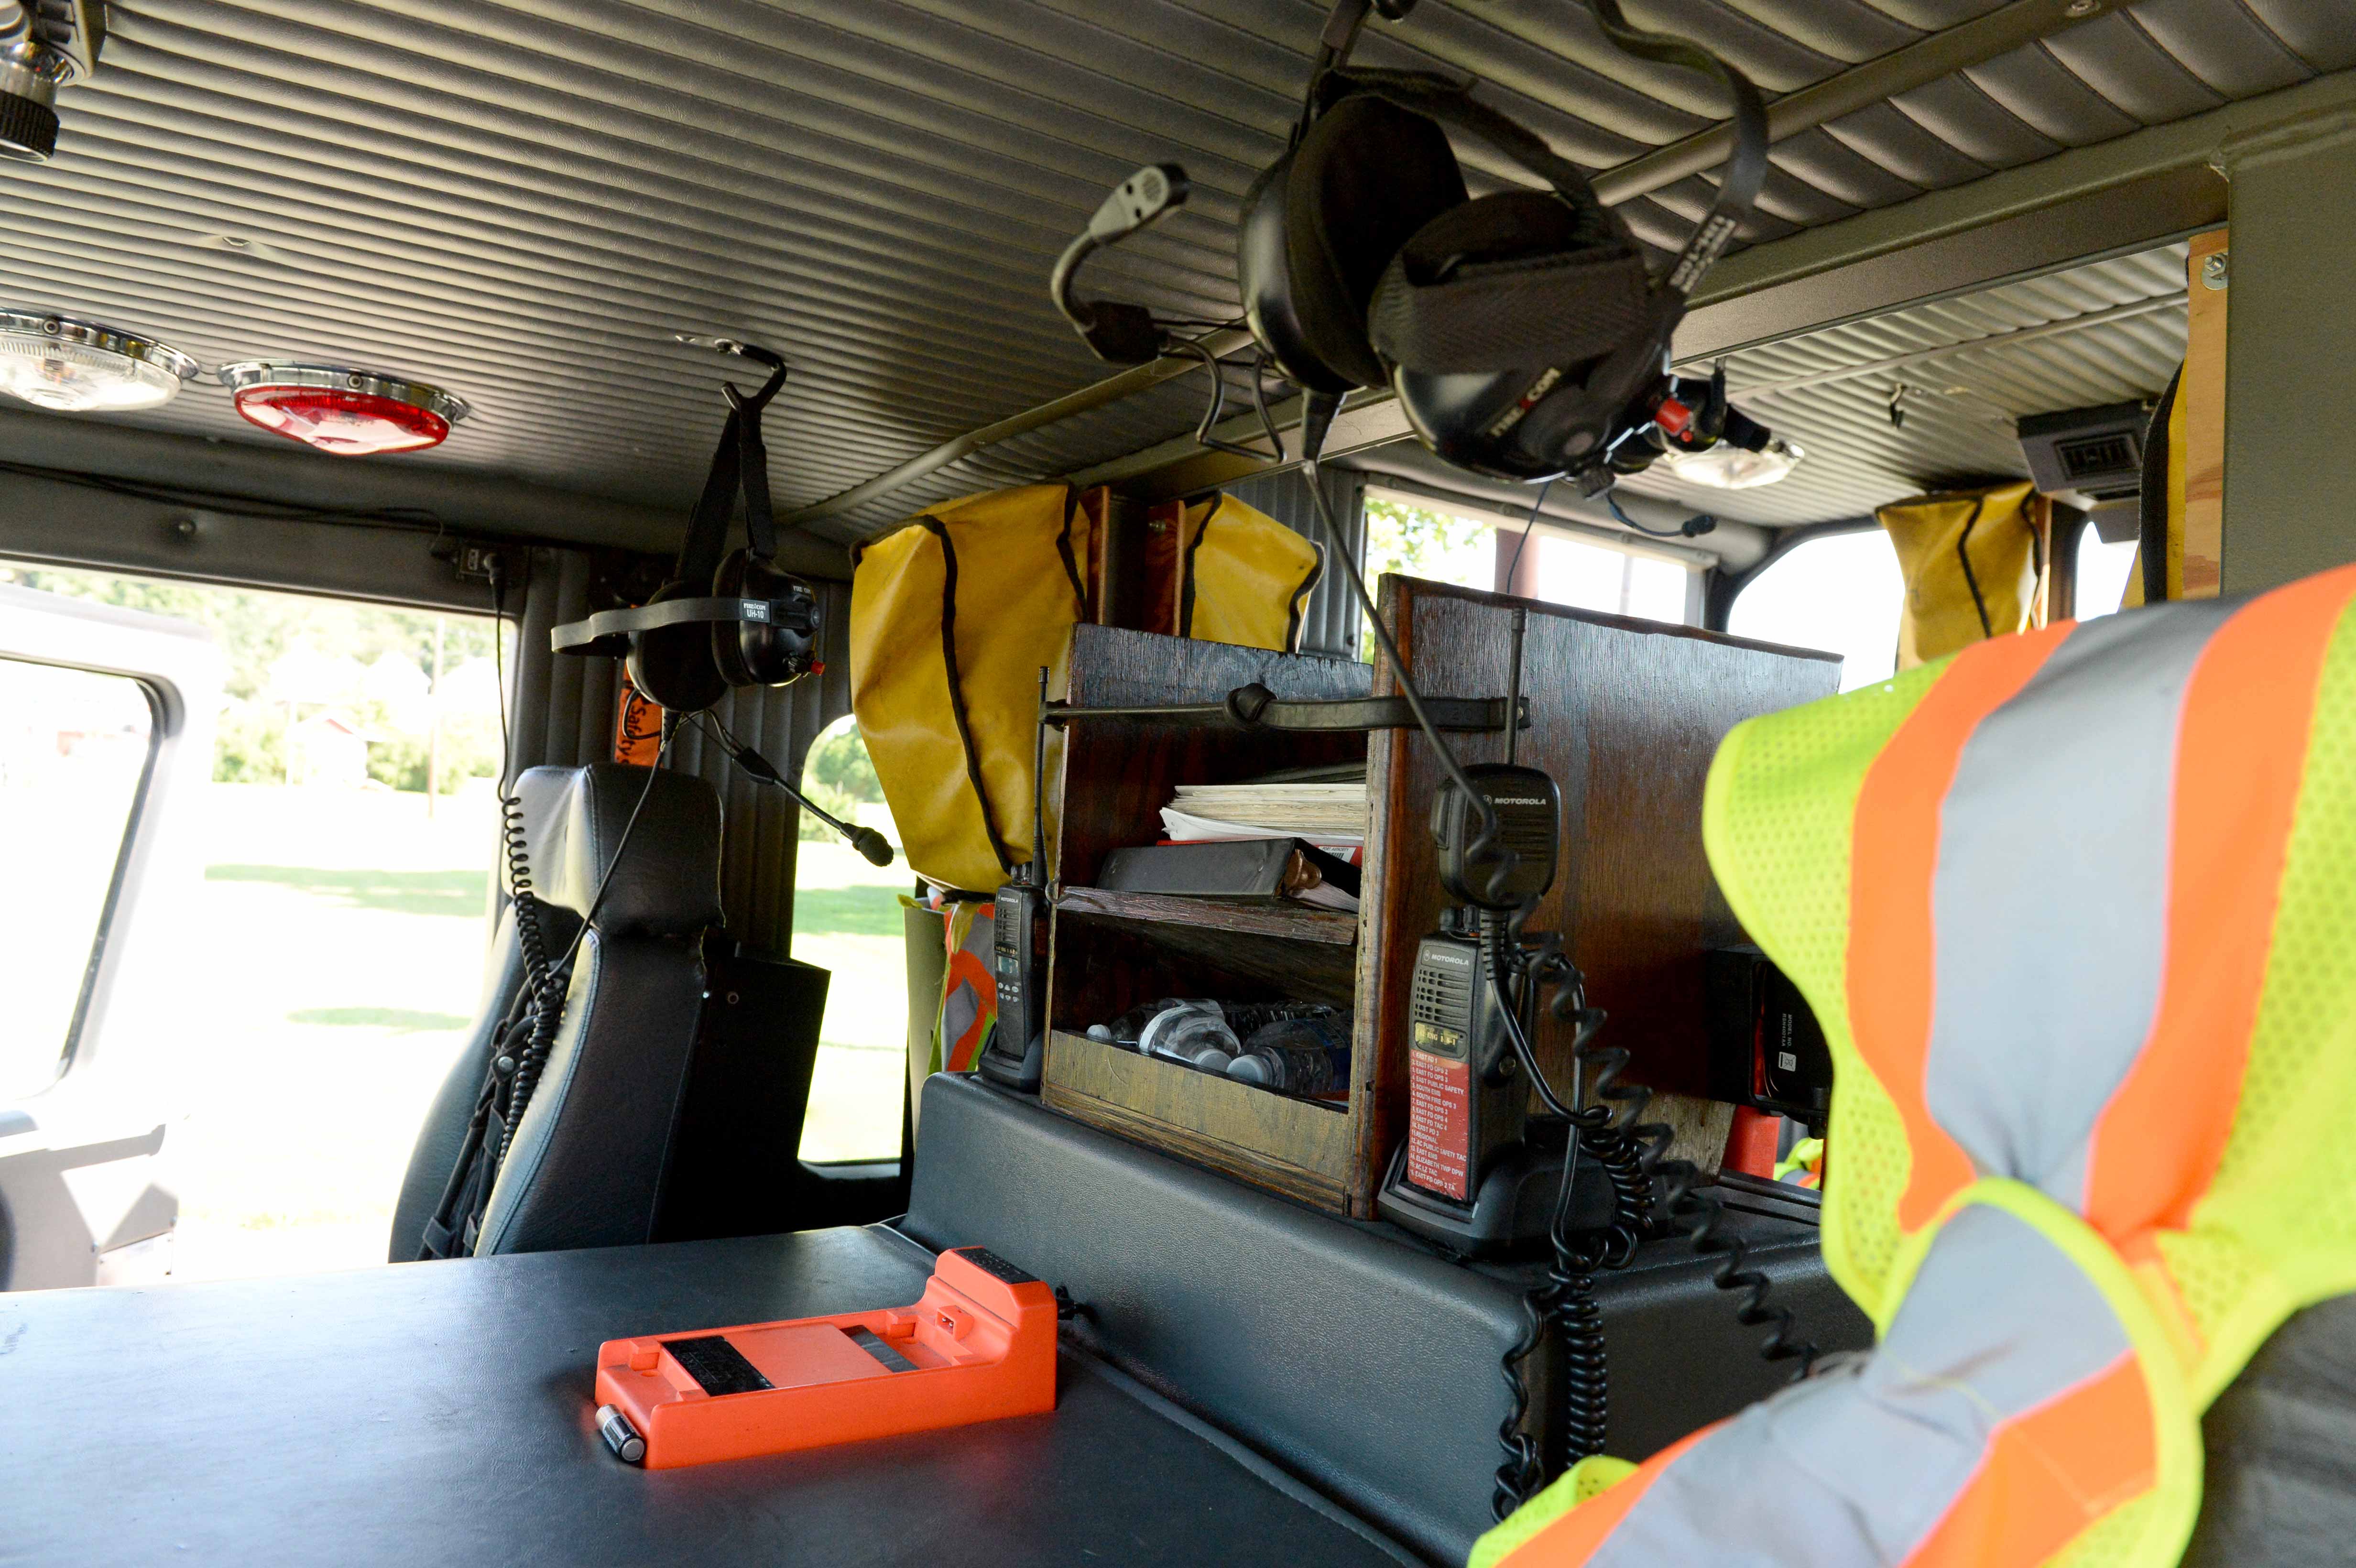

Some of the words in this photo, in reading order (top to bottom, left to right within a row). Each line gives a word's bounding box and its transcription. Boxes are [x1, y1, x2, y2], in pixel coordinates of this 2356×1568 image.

[747, 609, 764, 619] UH-10
[1431, 953, 1469, 966] MOTOROLA
[1416, 1060, 1427, 1068] EAST
[1416, 1068, 1427, 1076] EAST
[1416, 1076, 1427, 1084] EAST
[1428, 1079, 1444, 1089] PUBLIC
[1445, 1085, 1464, 1095] SAFETY
[1416, 1083, 1430, 1094] SOUTH
[1416, 1092, 1430, 1101] SOUTH
[1431, 1096, 1441, 1105] FIRE
[1442, 1100, 1452, 1109] OPS
[1416, 1100, 1427, 1108] EAST
[1416, 1107, 1427, 1116] EAST
[1434, 1113, 1444, 1122] OPS
[1416, 1115, 1426, 1123] EAST
[1434, 1122, 1443, 1130] TAC
[1418, 1123, 1429, 1132] EAST
[1417, 1147, 1427, 1156] EAST
[1428, 1152, 1438, 1160] EMS
[1423, 1142, 1439, 1152] PUBLIC
[1440, 1148, 1455, 1158] SAFETY
[1456, 1153, 1467, 1161] TAC
[1416, 1155, 1440, 1169] ELIZABETH
[1440, 1164, 1451, 1172] TWP
[1451, 1168, 1463, 1177] DPW
[1429, 1167, 1438, 1176] TAC
[1415, 1171, 1426, 1180] EAST
[1433, 1177, 1443, 1186] OPS
